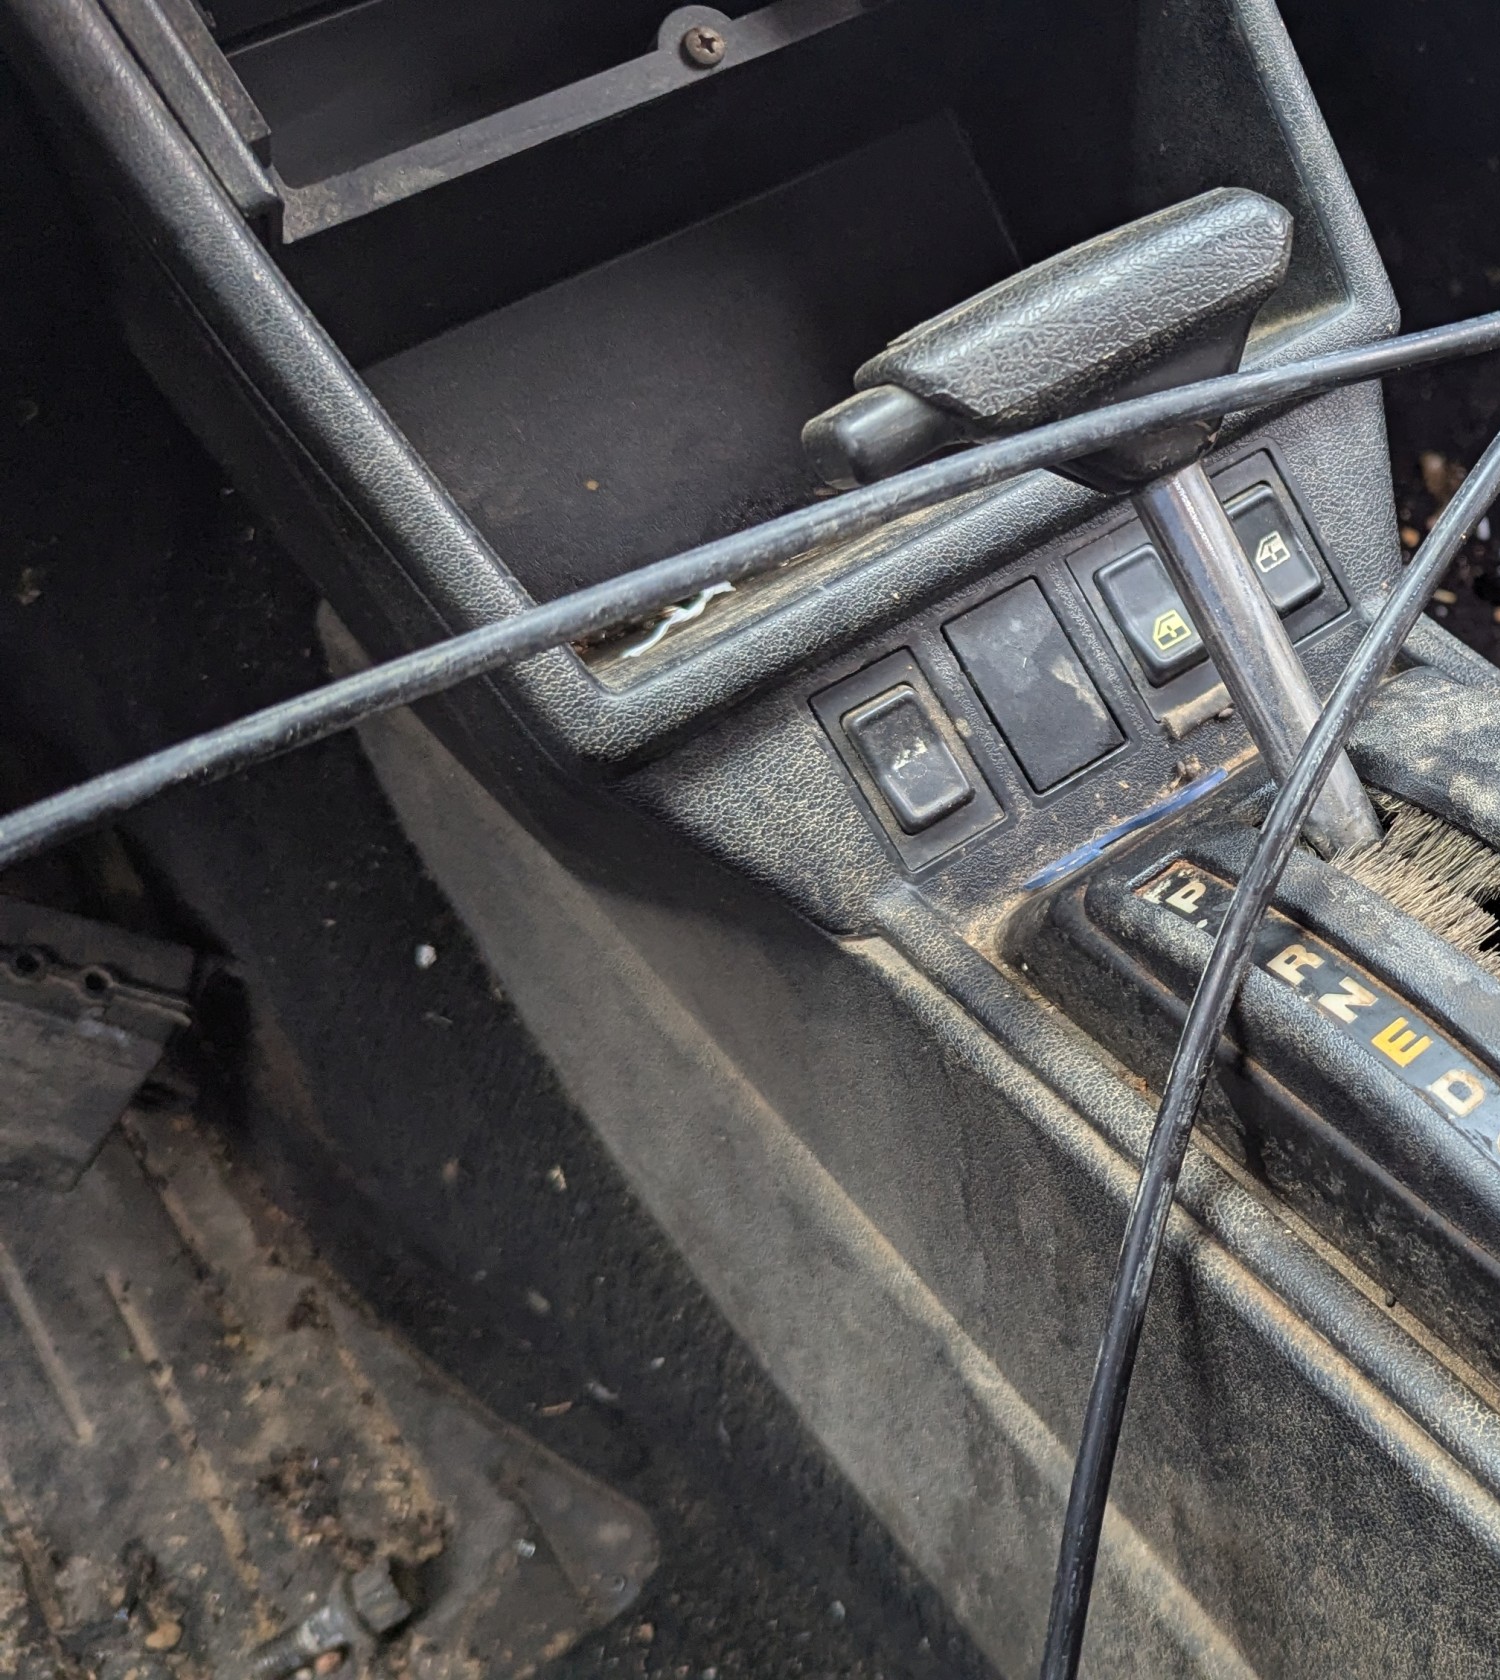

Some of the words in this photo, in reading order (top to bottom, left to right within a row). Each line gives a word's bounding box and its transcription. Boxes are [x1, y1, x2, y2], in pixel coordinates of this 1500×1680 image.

[1165, 881, 1206, 914] P
[1266, 944, 1325, 986] R
[1318, 976, 1379, 1024] N
[1371, 1017, 1433, 1068] E
[1430, 1068, 1485, 1117] D
